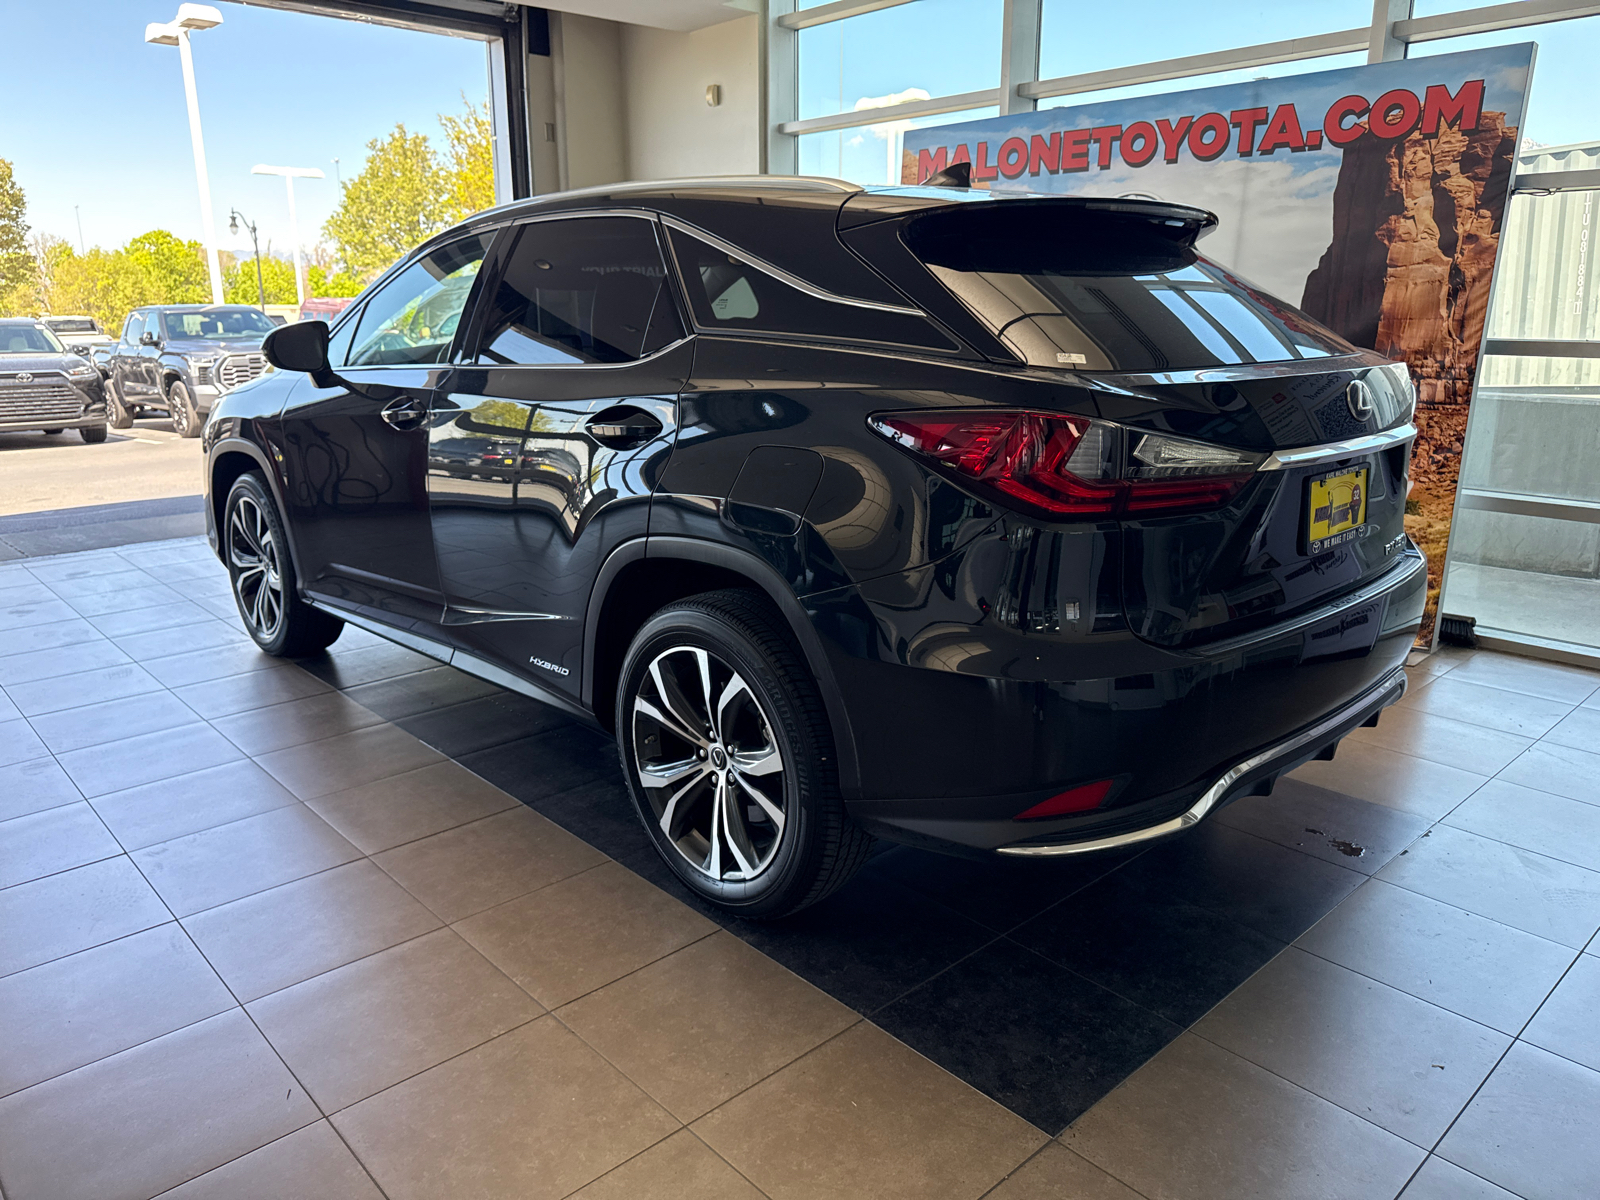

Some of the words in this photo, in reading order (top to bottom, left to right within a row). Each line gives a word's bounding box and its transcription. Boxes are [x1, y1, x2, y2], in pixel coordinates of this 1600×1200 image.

[916, 79, 1486, 187] MALONETOYOTA.COM
[1353, 489, 1360, 500] 32
[1323, 538, 1331, 549] WE
[1331, 534, 1342, 547] MAKE
[1347, 531, 1356, 541] EASY
[529, 656, 570, 676] HYBRID
